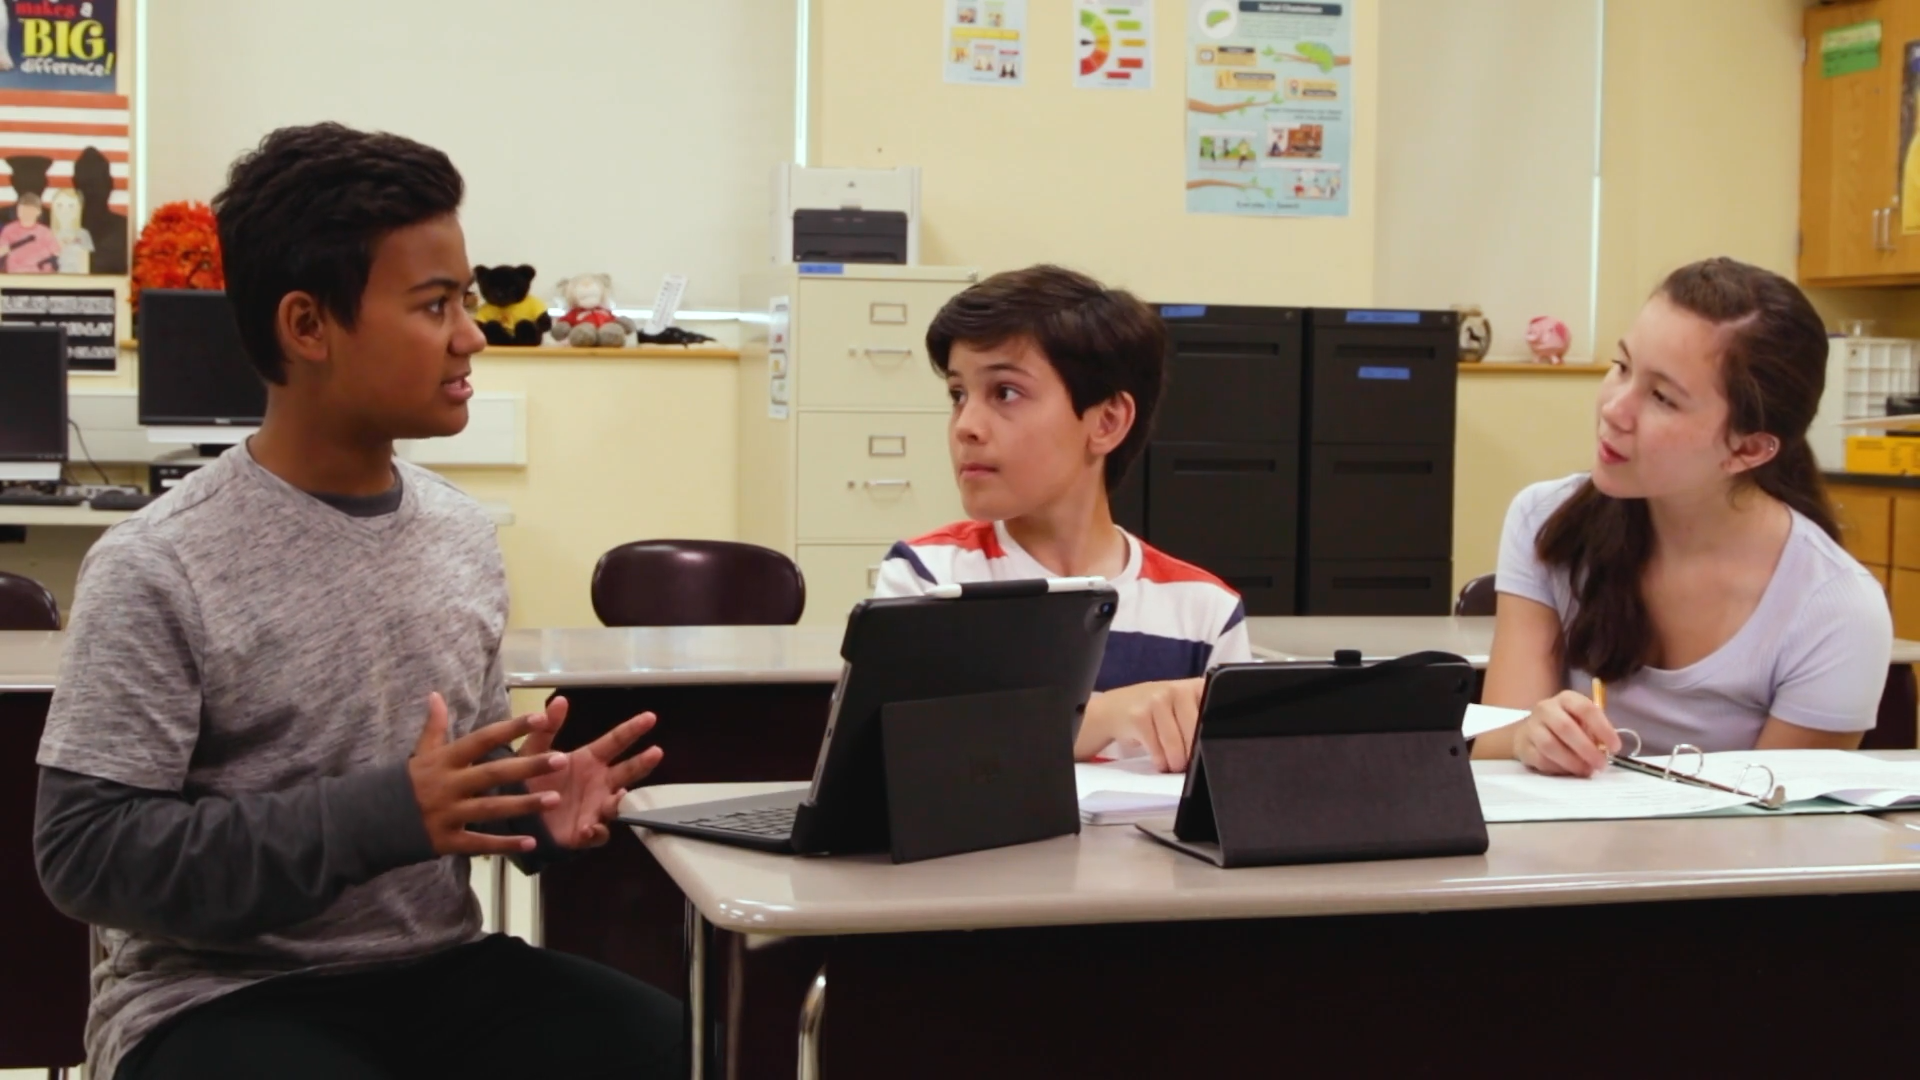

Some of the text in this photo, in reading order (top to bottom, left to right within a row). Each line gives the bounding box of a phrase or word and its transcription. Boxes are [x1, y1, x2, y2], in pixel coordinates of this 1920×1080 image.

[15, 0, 93, 18] makes a
[19, 18, 105, 60] BIG
[20, 52, 114, 77] difference!
